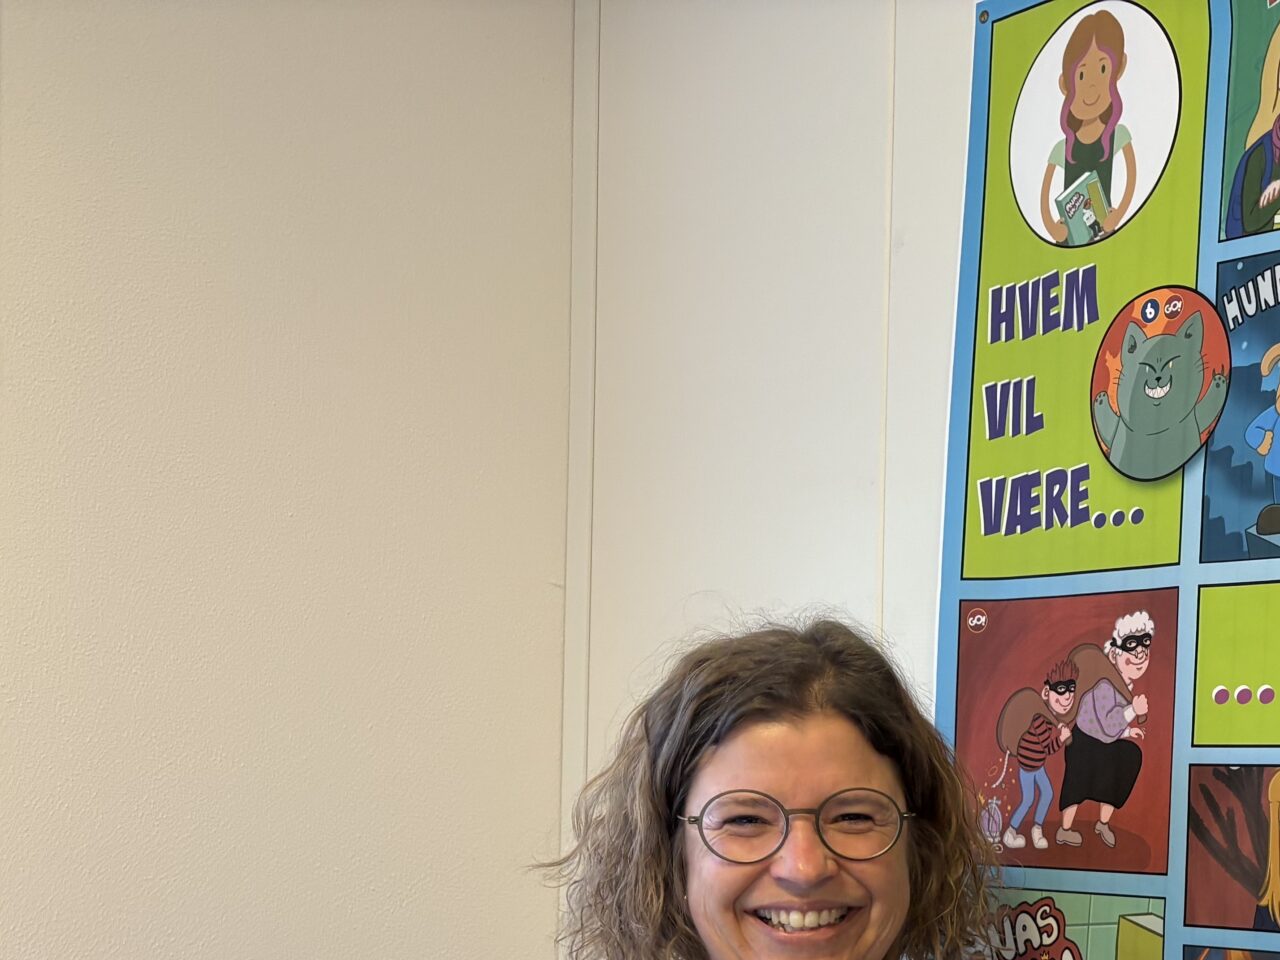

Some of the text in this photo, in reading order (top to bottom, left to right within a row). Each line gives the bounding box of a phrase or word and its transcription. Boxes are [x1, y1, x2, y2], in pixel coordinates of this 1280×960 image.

[988, 262, 1099, 345] HVEM
[1164, 300, 1182, 314] GO!
[982, 375, 1044, 441] VIL
[976, 462, 1145, 537] VÆRE...
[968, 614, 986, 627] GO!
